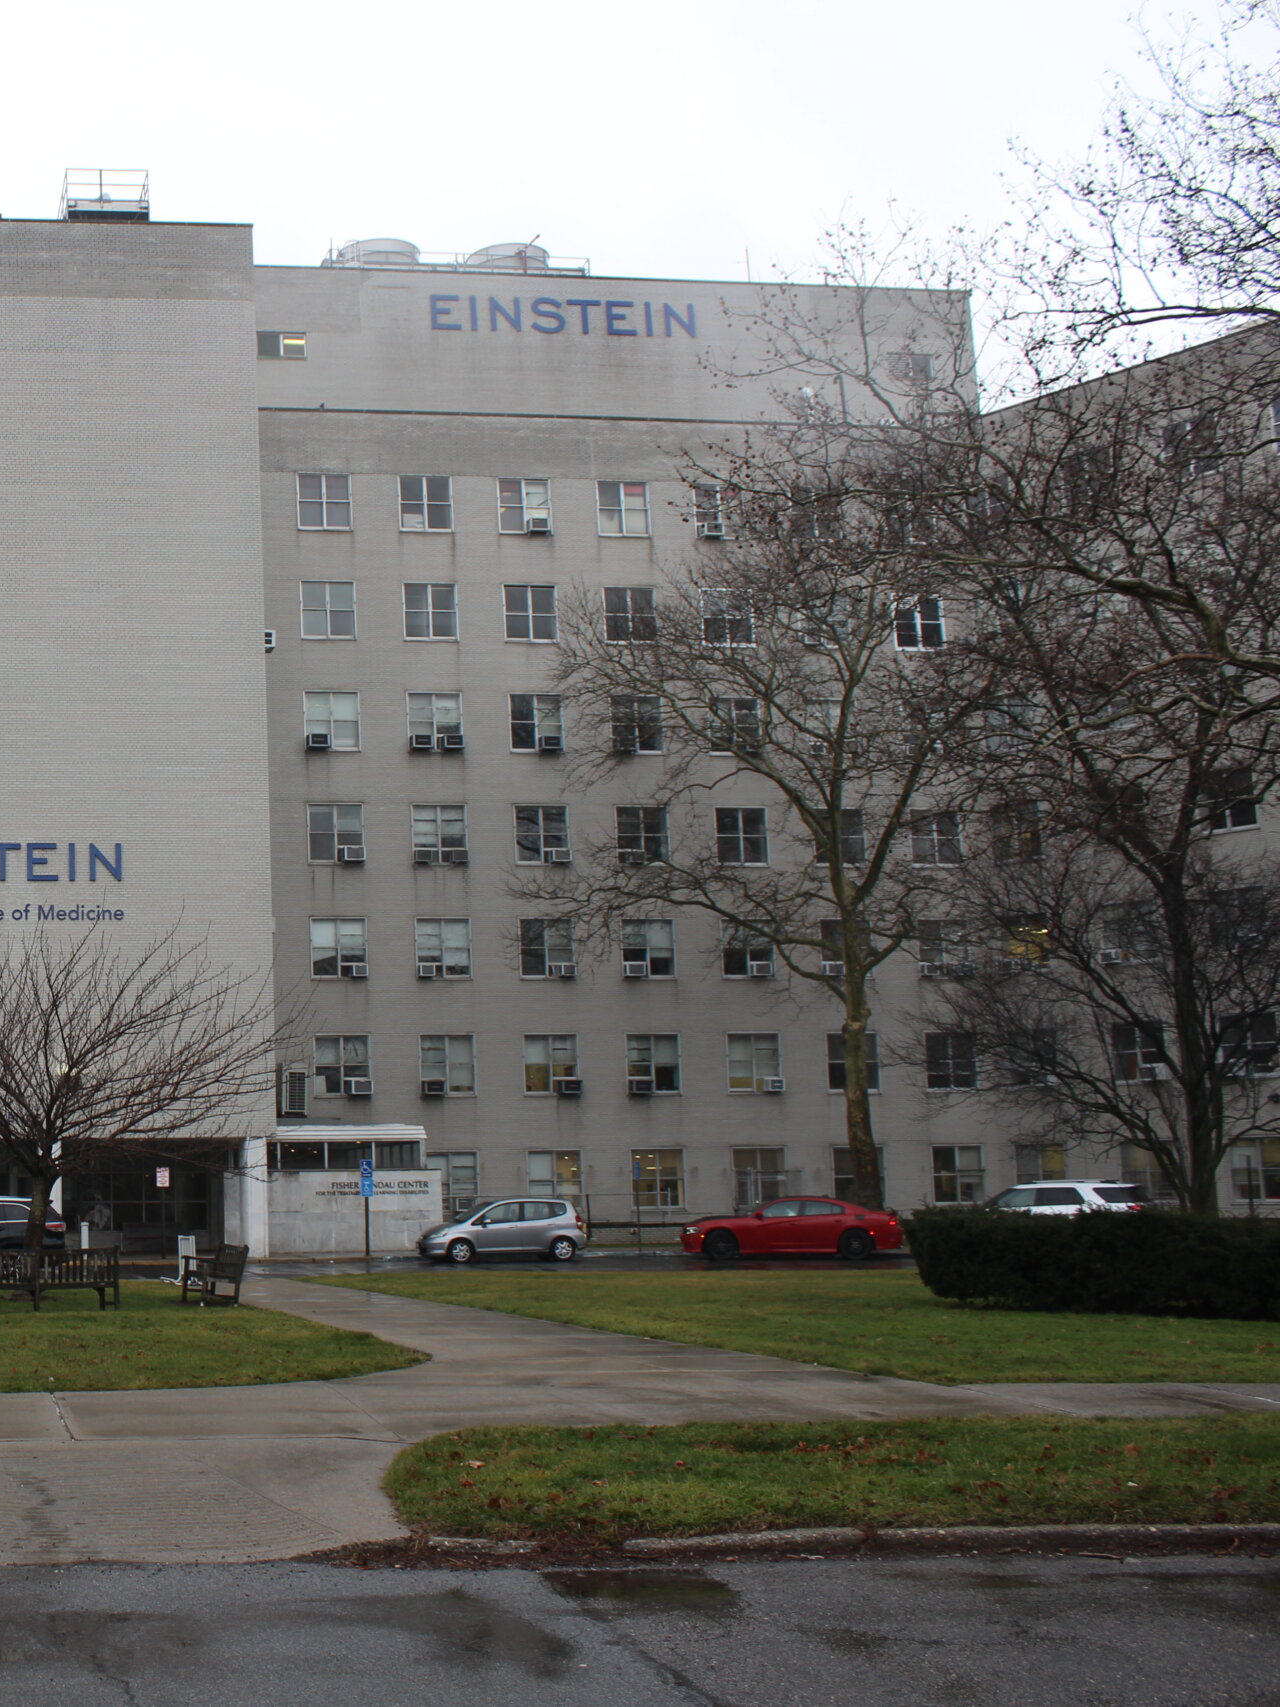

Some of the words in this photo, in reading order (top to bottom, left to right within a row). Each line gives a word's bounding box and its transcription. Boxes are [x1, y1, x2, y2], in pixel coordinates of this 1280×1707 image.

[430, 294, 697, 338] EINSTEIN
[11, 904, 31, 921] of
[37, 904, 125, 921] Medicine
[331, 1182, 360, 1190] FISHER
